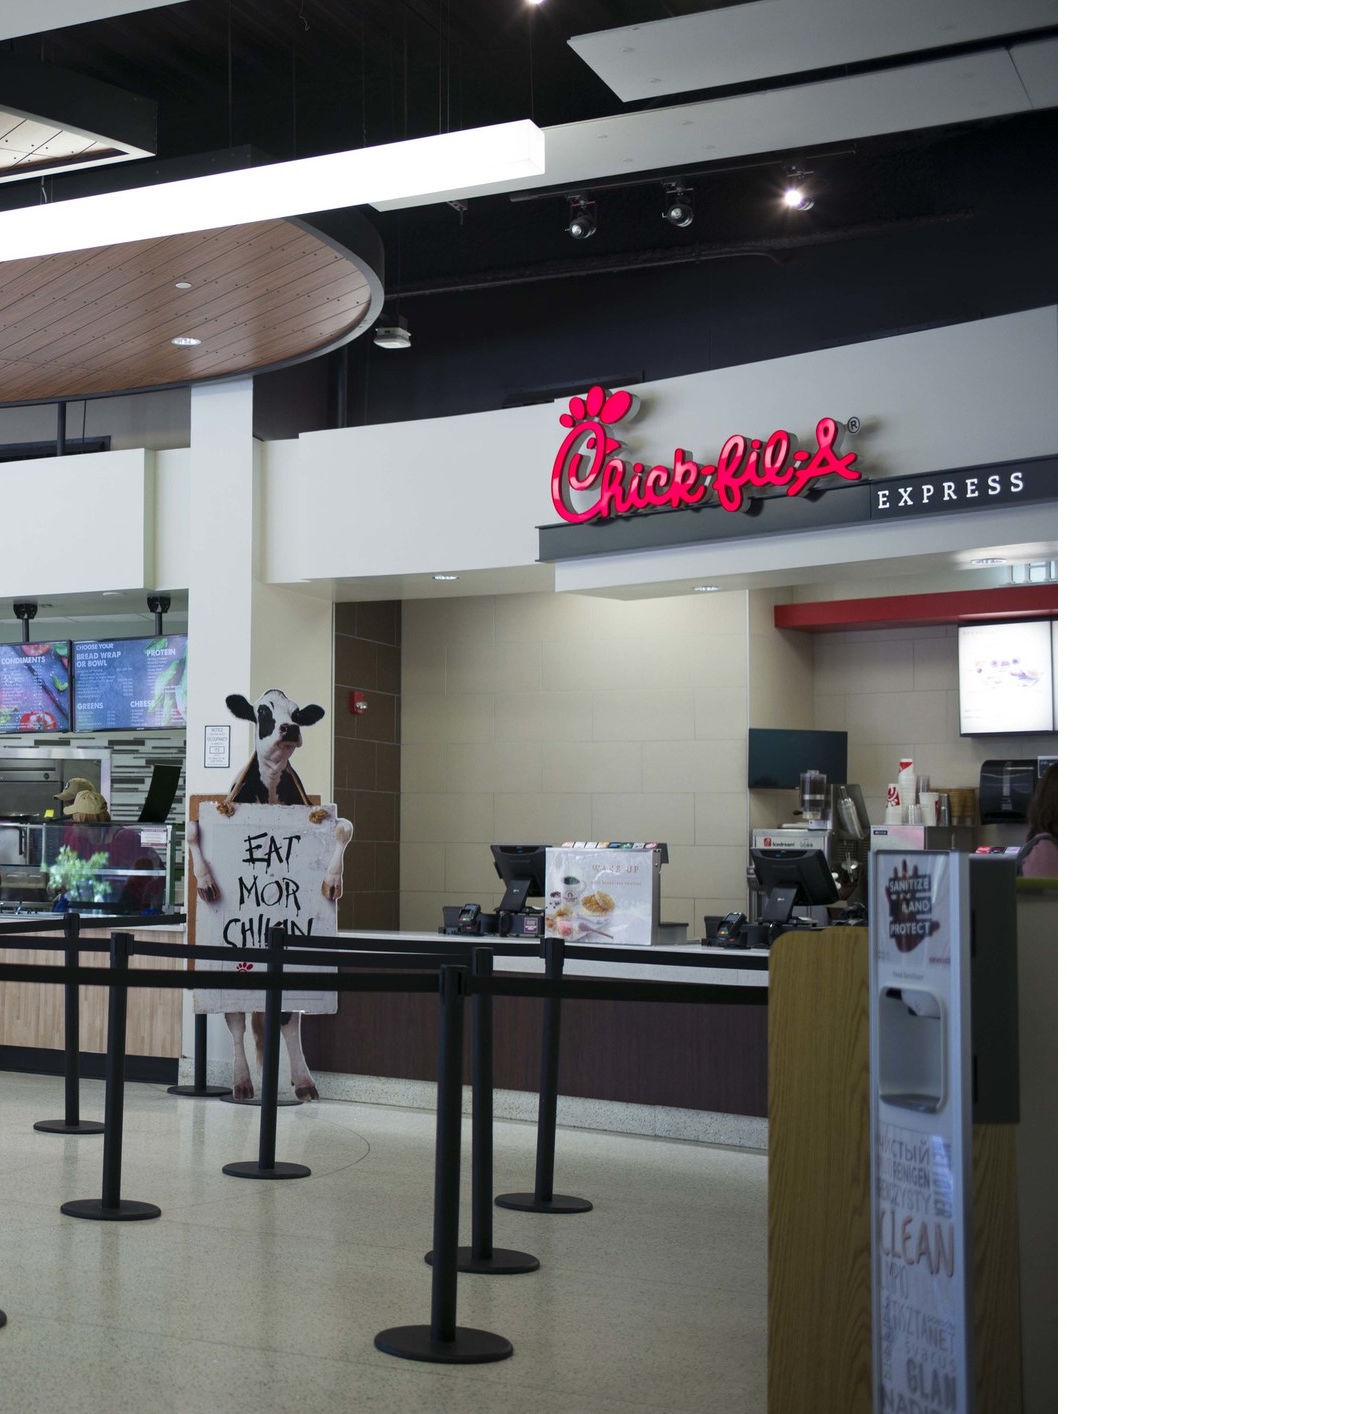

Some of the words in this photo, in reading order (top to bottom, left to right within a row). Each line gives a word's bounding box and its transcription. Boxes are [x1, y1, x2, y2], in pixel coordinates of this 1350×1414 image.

[551, 386, 863, 524] Chick-fil-A
[877, 472, 1024, 509] EXPRESS
[100, 651, 121, 659] WRAP
[146, 648, 176, 657] PROTEIN
[1, 656, 45, 665] CONDIMENTS
[77, 702, 103, 710] GREENS
[242, 832, 301, 874] EAT
[626, 865, 639, 873] UP
[890, 878, 929, 892] SANITIZE
[238, 875, 301, 917] MOR
[890, 922, 930, 935] PROTECT
[879, 1209, 954, 1279] CLEAN
